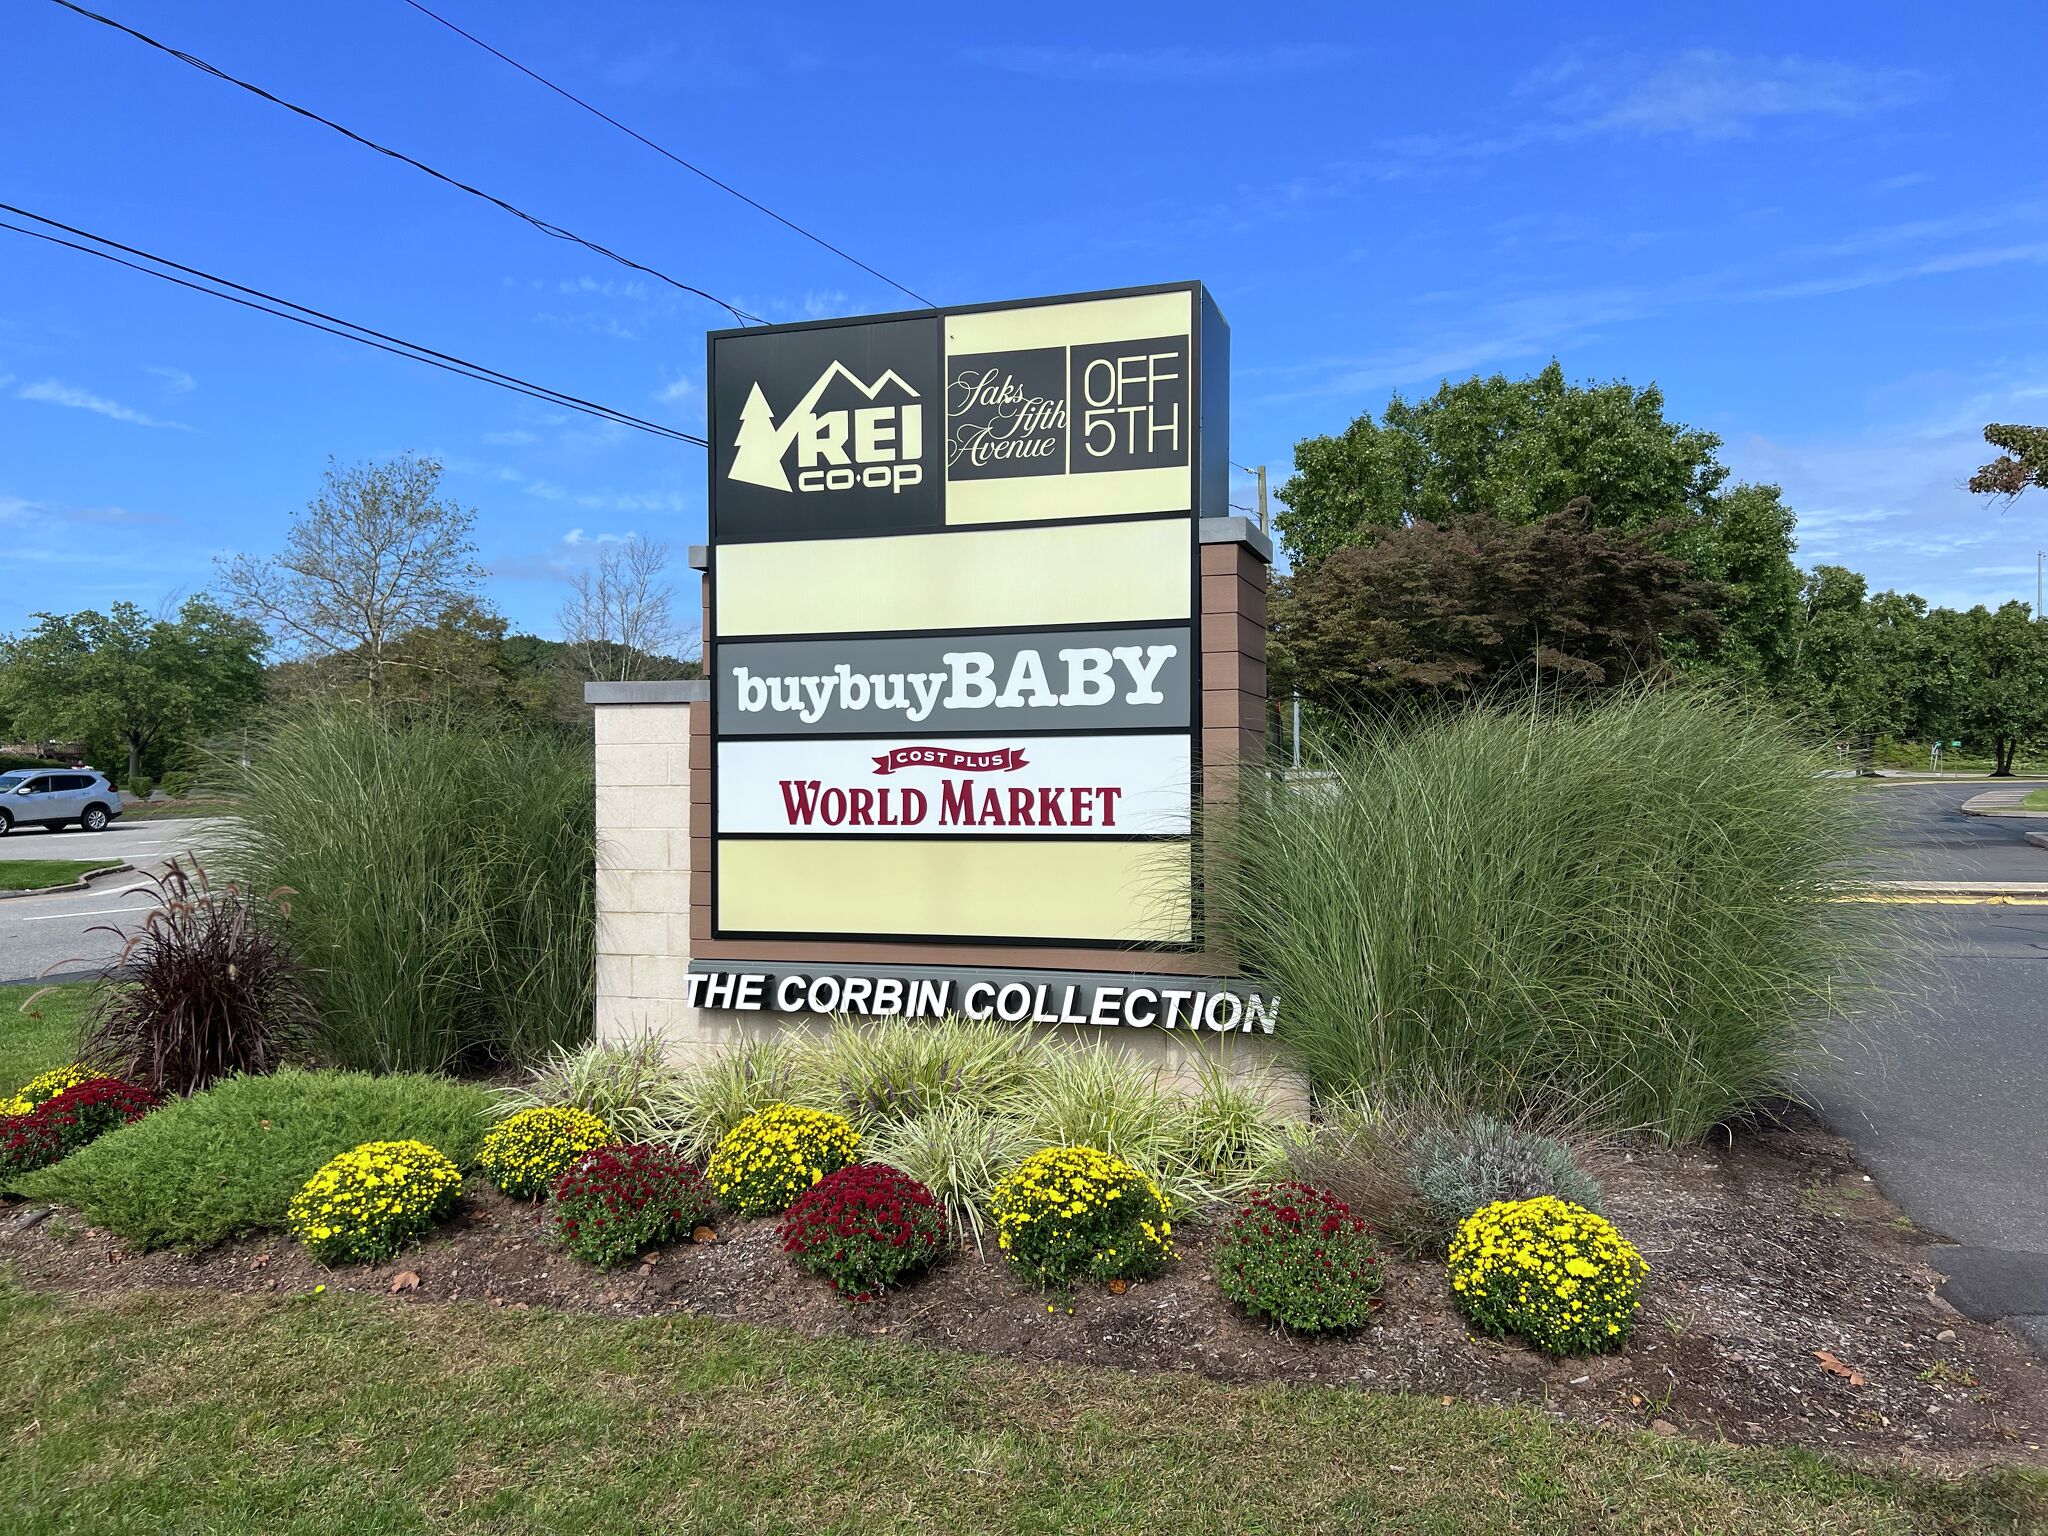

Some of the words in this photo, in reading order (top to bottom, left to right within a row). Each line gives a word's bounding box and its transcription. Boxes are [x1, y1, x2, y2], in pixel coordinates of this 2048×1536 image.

[948, 369, 1025, 416] Saks
[1084, 352, 1180, 407] OFF
[797, 403, 923, 468] REI
[948, 423, 1056, 468] Avenue
[1084, 403, 1180, 457] 5TH
[732, 644, 1178, 724] buybuyBABY
[896, 751, 947, 763] COST
[953, 755, 1003, 767] PLUS
[684, 974, 767, 1011] THE
[777, 975, 951, 1018] CORBIN
[964, 982, 1281, 1035] COLLECTION
